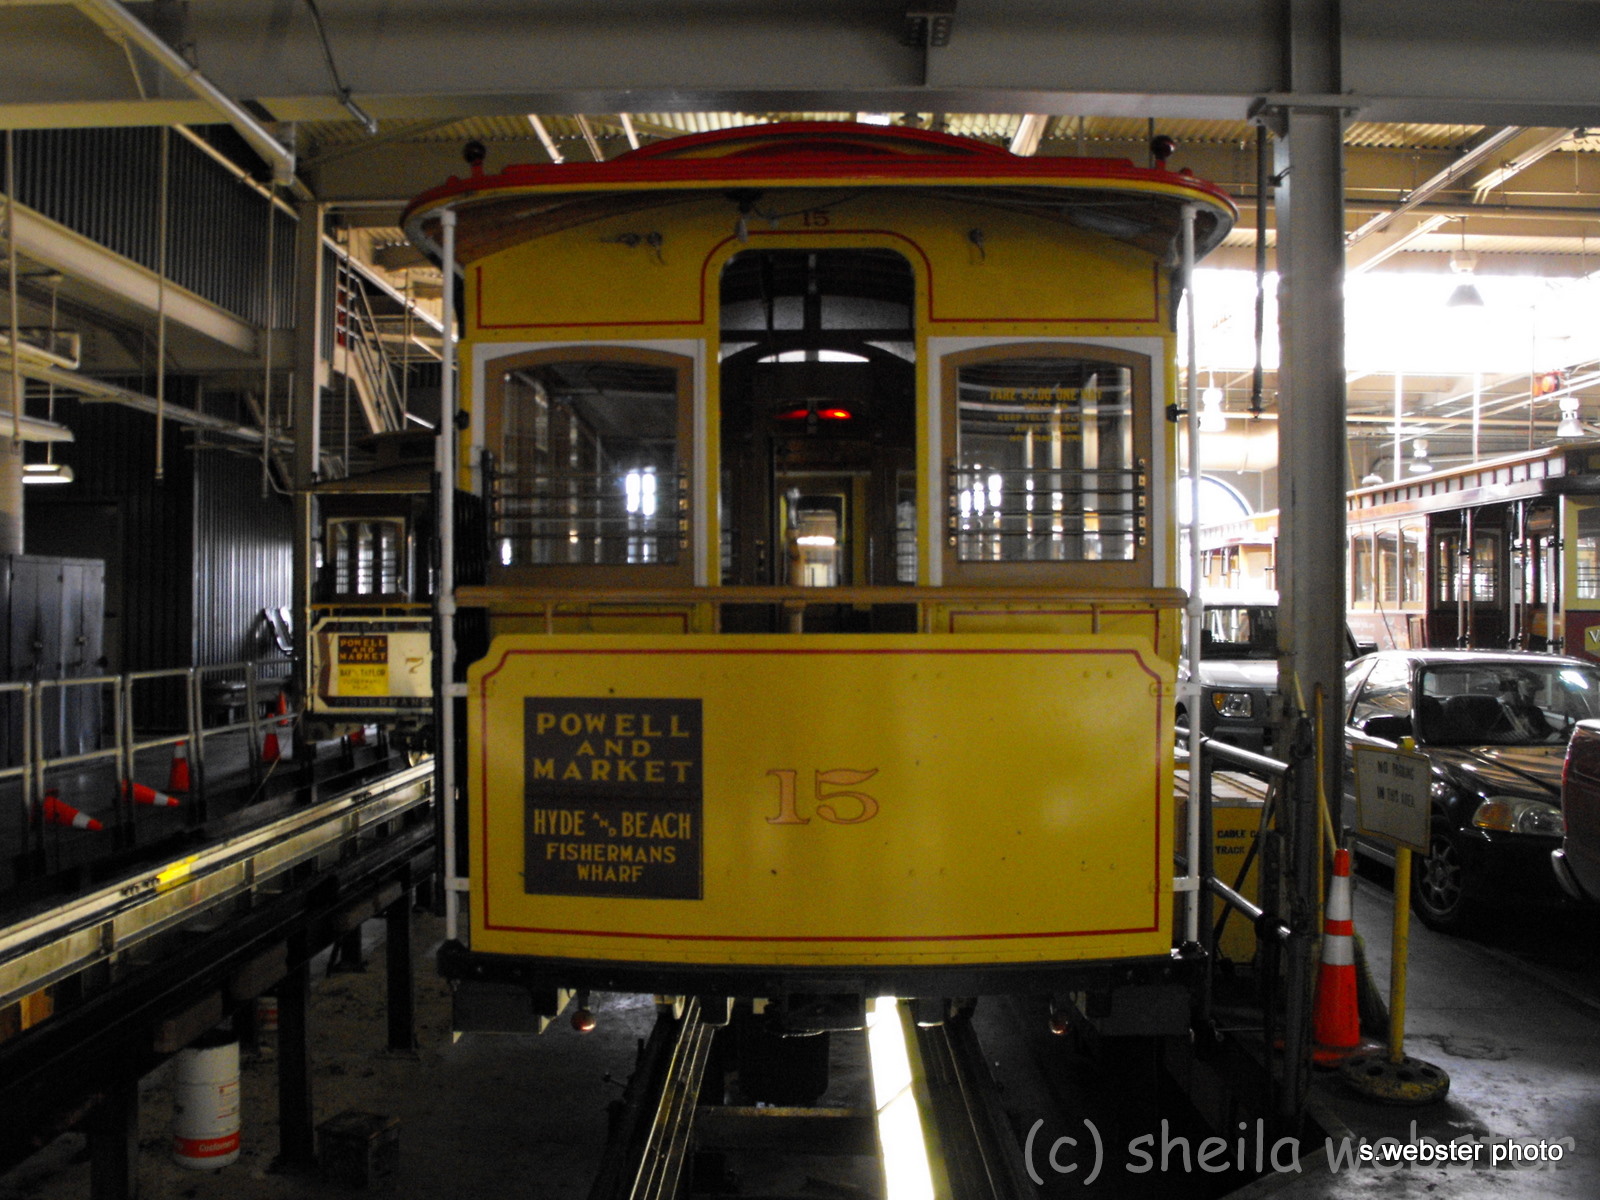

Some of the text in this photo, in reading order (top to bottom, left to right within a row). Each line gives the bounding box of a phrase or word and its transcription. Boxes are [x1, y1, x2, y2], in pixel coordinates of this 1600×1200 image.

[804, 210, 830, 226] 15
[340, 638, 386, 647] POWELL
[340, 652, 386, 661] MARKET
[405, 657, 424, 674] 7
[536, 712, 689, 738] POWELL
[576, 739, 651, 757] AND
[532, 758, 693, 783] MARKET
[765, 768, 879, 825] 15
[533, 809, 585, 836] HYDE
[621, 811, 691, 840] BEACH
[1217, 829, 1246, 838] CABLE
[546, 843, 676, 864] FISHERMANS
[1216, 846, 1245, 854] TRACK
[577, 864, 643, 882] WHARF
